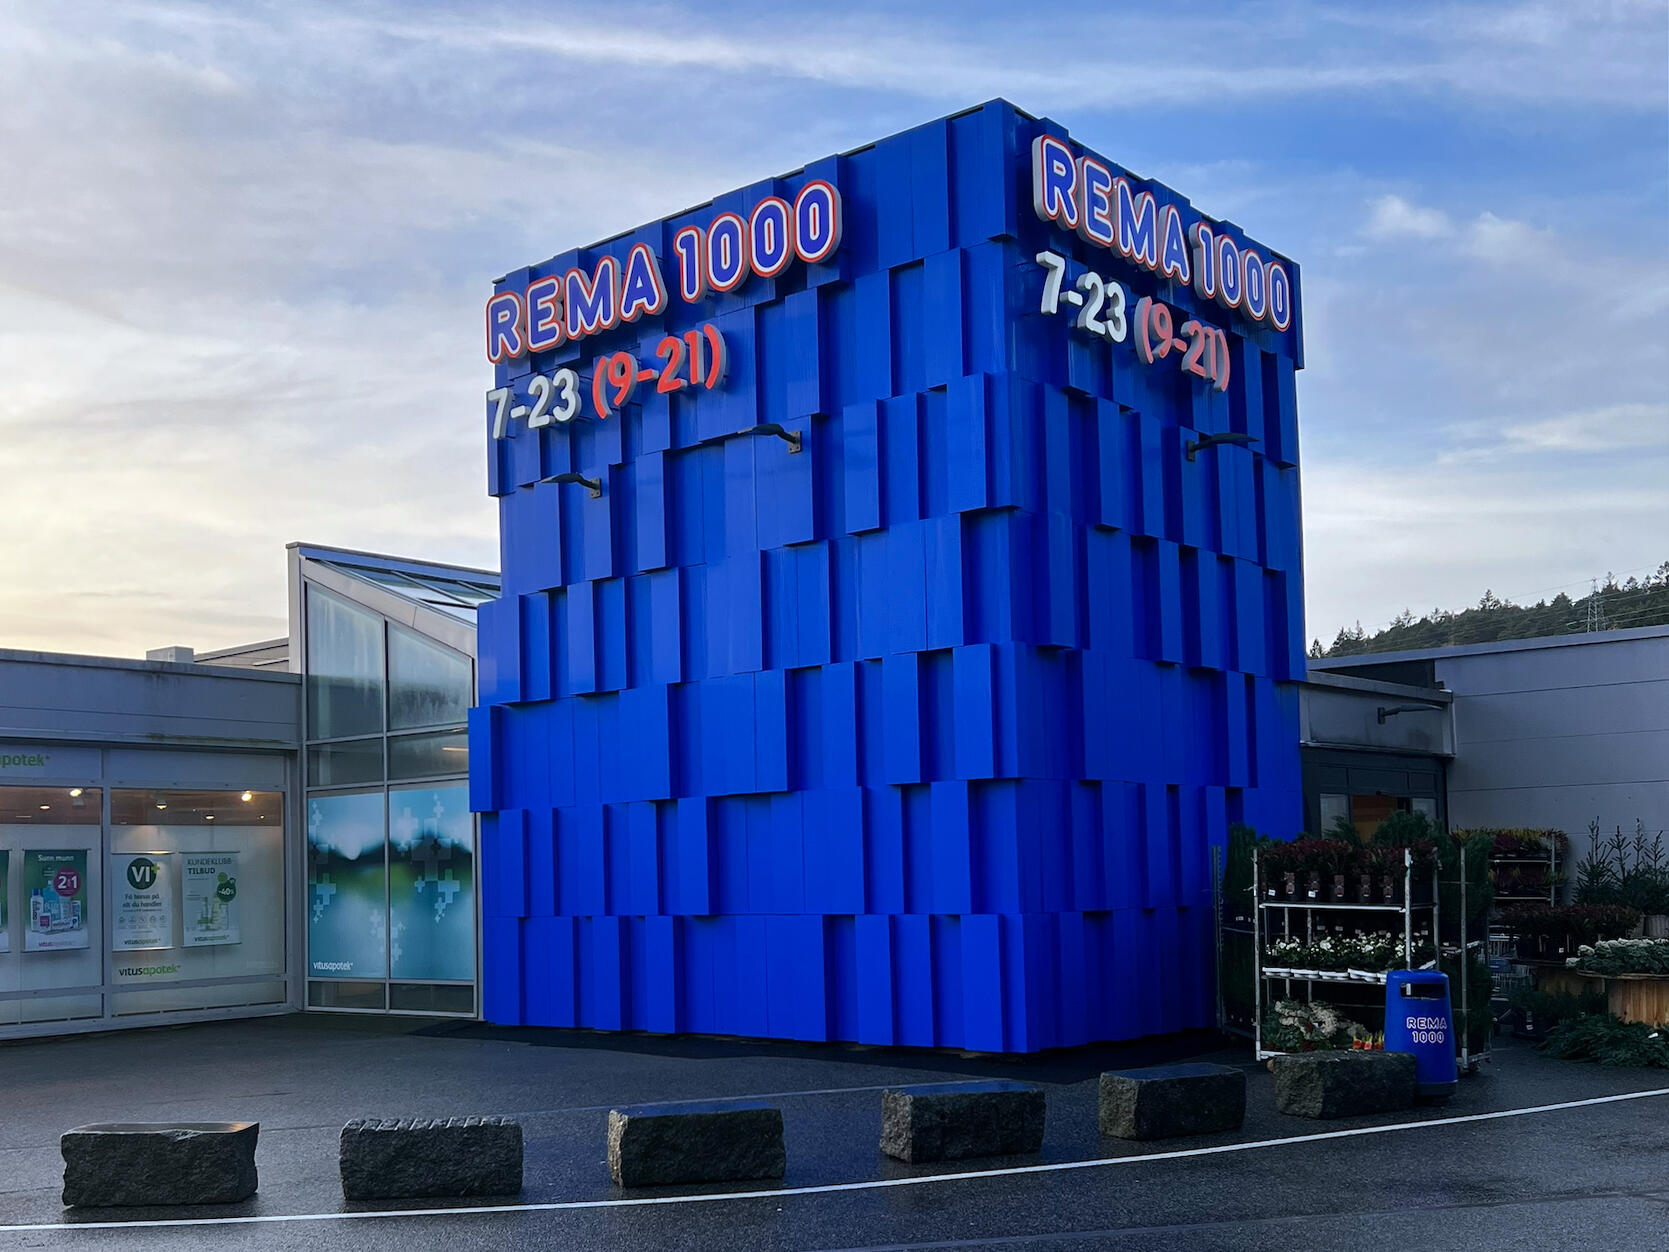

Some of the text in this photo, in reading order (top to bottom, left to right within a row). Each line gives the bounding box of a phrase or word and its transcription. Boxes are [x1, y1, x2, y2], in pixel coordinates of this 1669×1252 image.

[1032, 134, 1291, 332] REMA 1000
[486, 180, 842, 364] REMA 1000
[1036, 251, 1230, 392] 7-23 (9-21)
[487, 323, 726, 440] 7-23 (9-21)
[58, 875, 67, 889] 2
[71, 875, 78, 889] 1
[119, 964, 177, 976] vitusapotek
[1406, 1016, 1447, 1030] REMA
[1412, 1031, 1445, 1044] 1000
